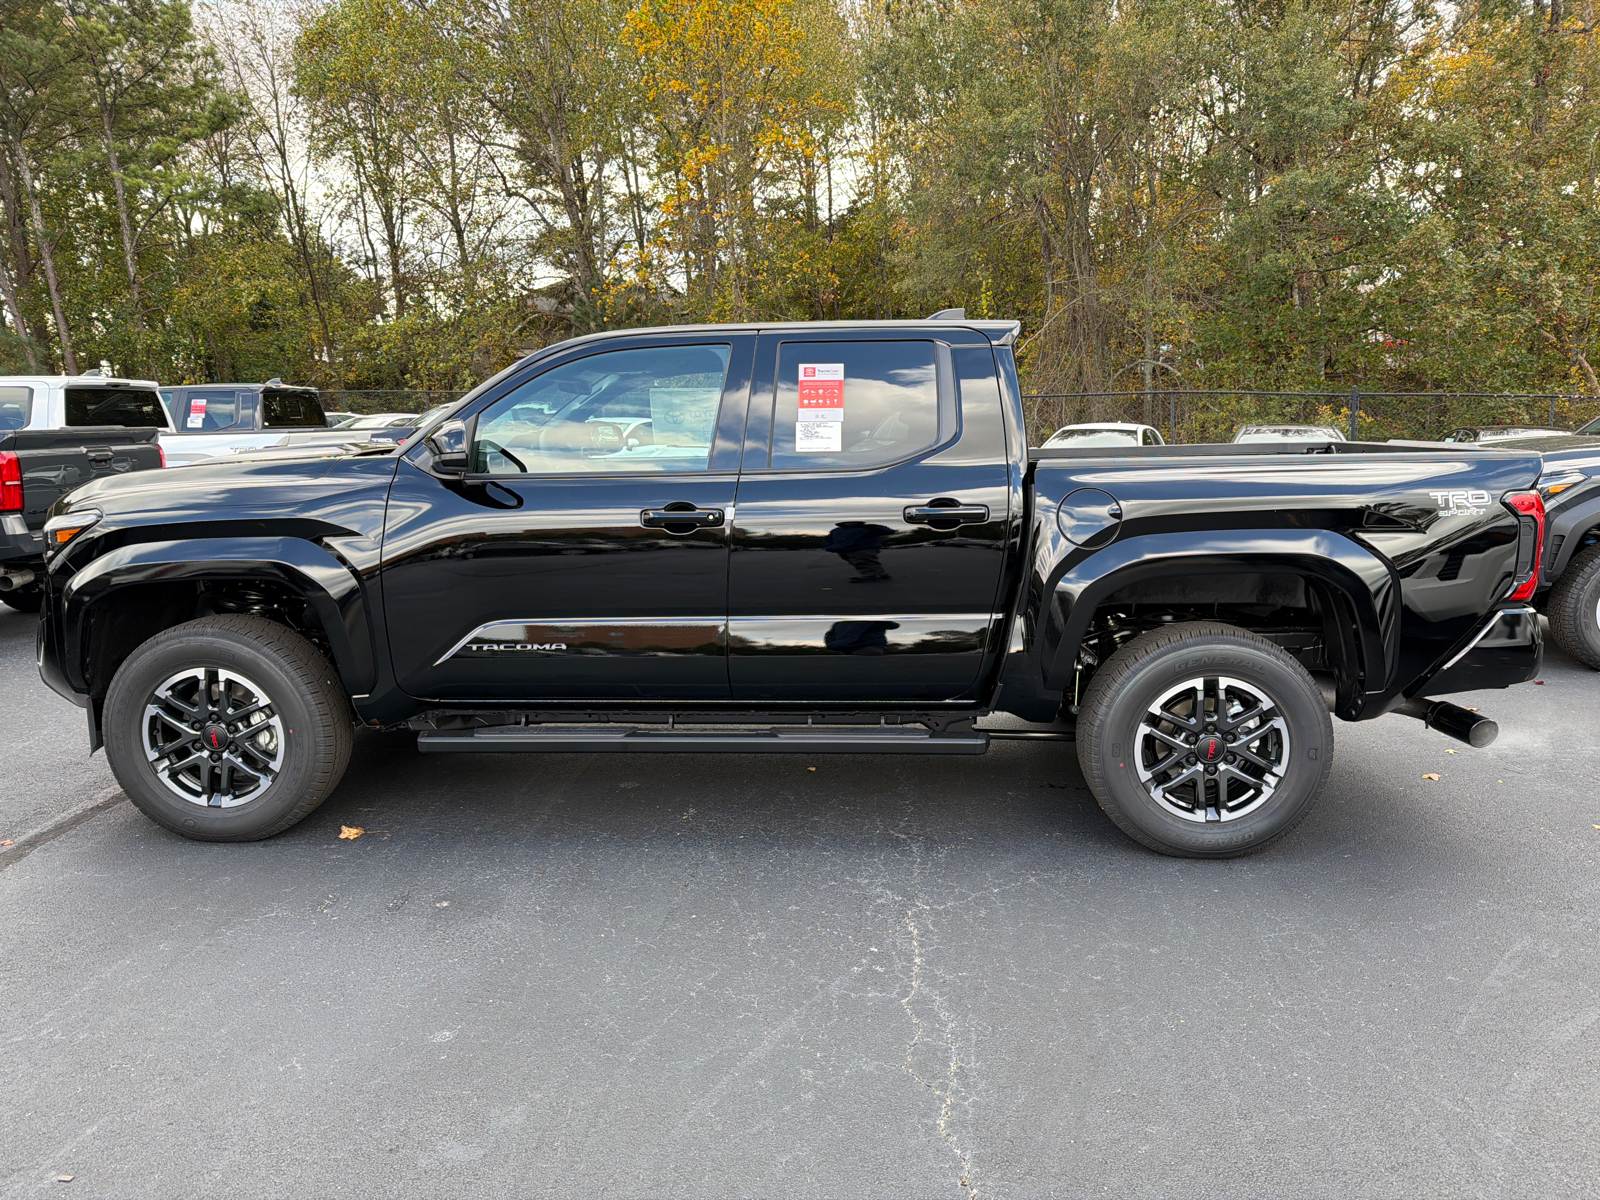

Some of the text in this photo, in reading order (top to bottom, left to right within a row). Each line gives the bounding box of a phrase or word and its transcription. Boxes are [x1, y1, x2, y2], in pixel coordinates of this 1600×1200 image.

[1429, 490, 1492, 510] TRD
[1438, 507, 1487, 517] SPORT
[466, 643, 567, 651] TACOMA
[1173, 654, 1265, 674] GENERAL
[210, 728, 219, 748] TRD
[1207, 739, 1216, 760] TRD
